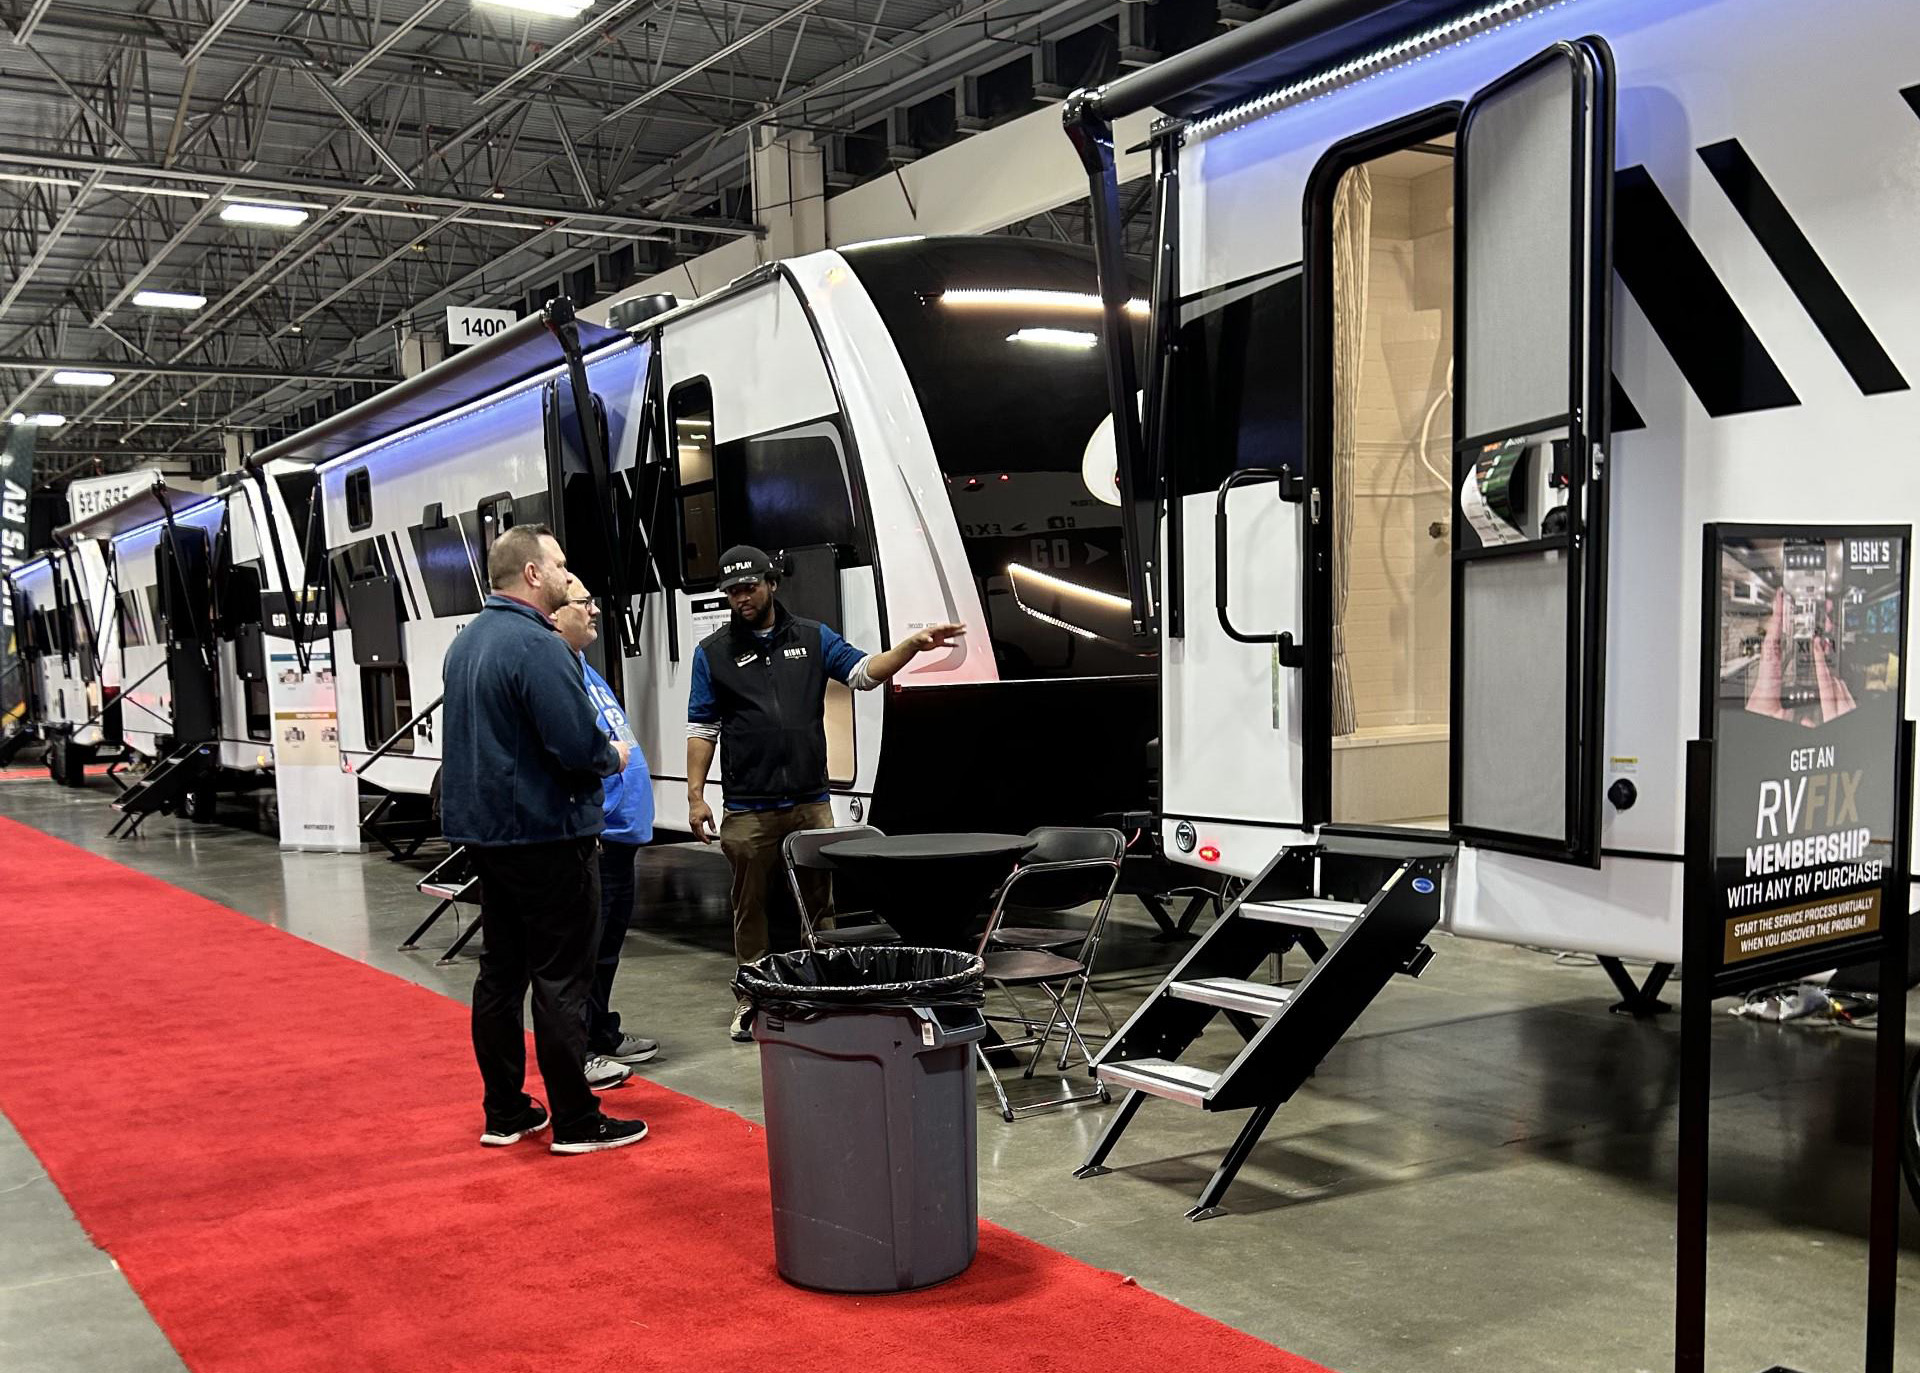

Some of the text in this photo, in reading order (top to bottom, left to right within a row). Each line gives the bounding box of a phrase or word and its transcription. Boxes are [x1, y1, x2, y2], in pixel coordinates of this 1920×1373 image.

[461, 317, 507, 337] 1400
[3, 479, 27, 523] RV
[736, 561, 752, 571] PLAY
[1030, 538, 1071, 569] GO
[1850, 541, 1890, 562] BISH'S
[783, 647, 807, 657] BISH'S
[1790, 746, 1835, 772] GET AN
[1745, 828, 1870, 877] MEMBERSHIP
[1727, 859, 1883, 909] WITH ANY RV PURCHASE!
[1734, 896, 1874, 938] START THE SERVICE PROCESS VIRTUALLY
[1740, 914, 1866, 953] WHEN YOU DISCOVER THE PROBLEM!
